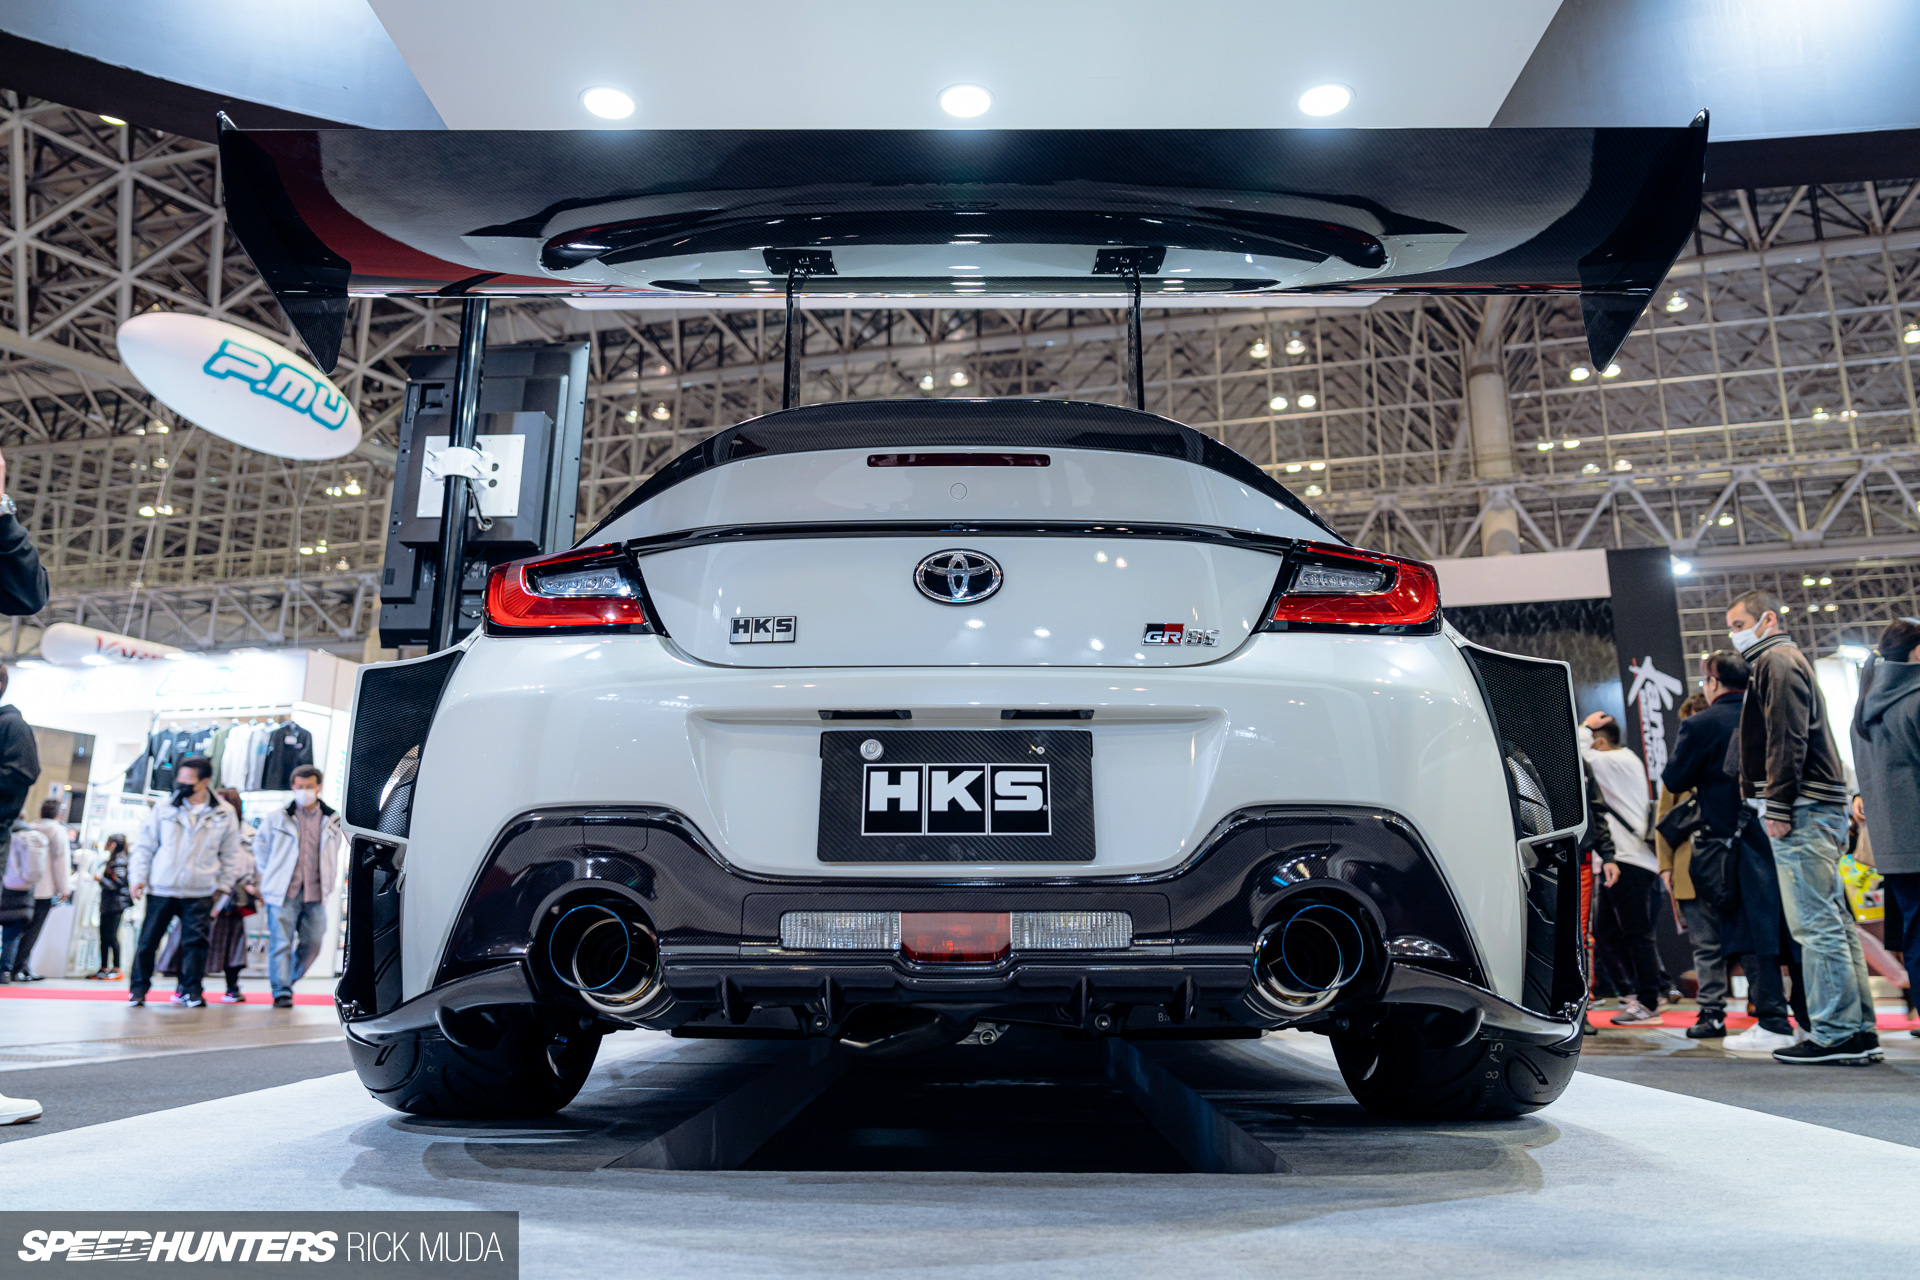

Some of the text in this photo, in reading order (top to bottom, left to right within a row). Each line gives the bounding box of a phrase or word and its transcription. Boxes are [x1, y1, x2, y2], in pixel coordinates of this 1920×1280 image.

[733, 618, 793, 634] HKS
[1144, 630, 1182, 644] GR
[867, 770, 1045, 812] HKS
